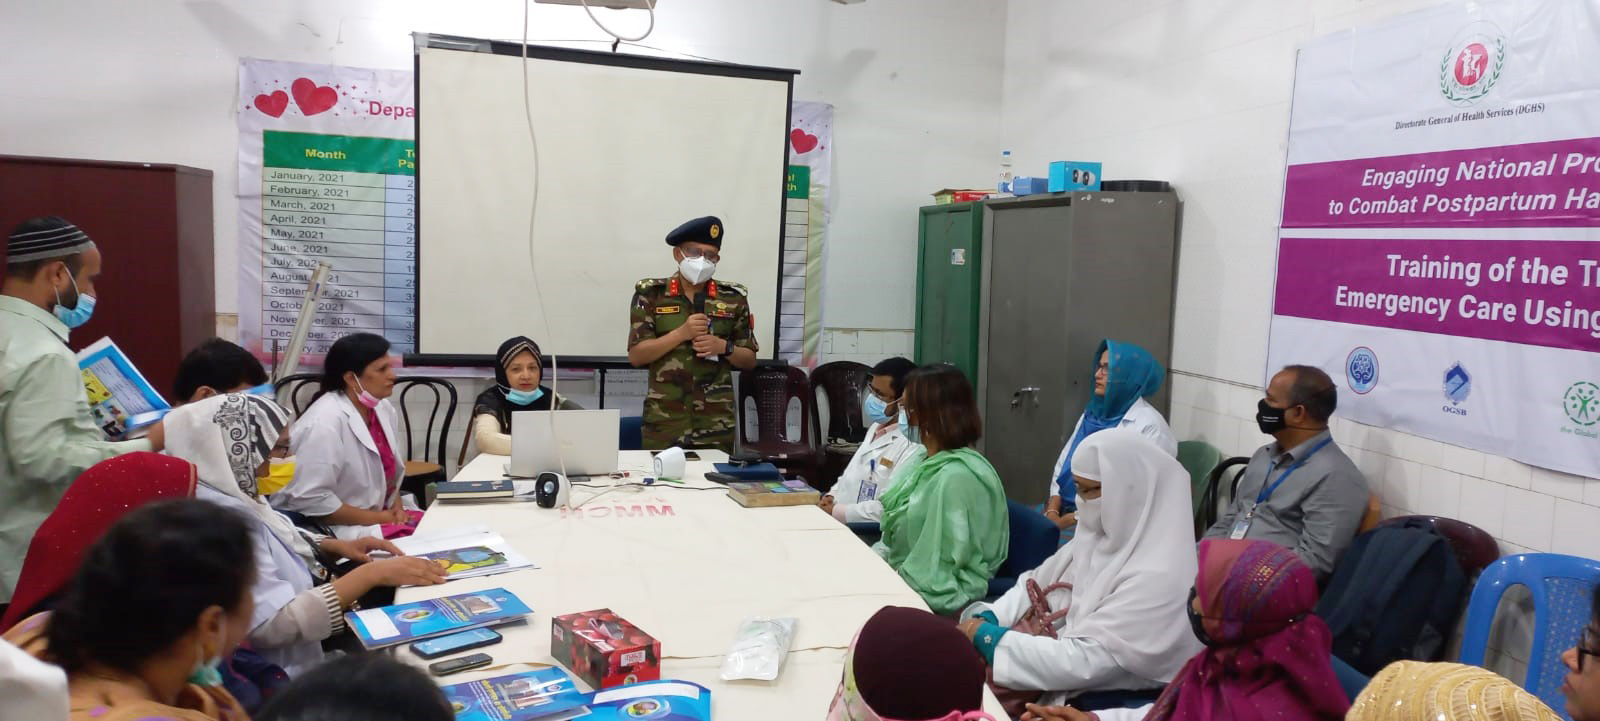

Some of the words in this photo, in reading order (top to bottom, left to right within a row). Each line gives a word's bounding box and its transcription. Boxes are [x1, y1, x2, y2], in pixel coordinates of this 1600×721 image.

[1395, 119, 1427, 130] Directorate
[1428, 115, 1453, 126] General
[1453, 113, 1461, 122] of
[1462, 110, 1485, 122] Health
[1486, 106, 1514, 119] Services
[1515, 103, 1545, 116] (DGHS)
[305, 149, 346, 160] Month
[271, 171, 315, 182] January,
[318, 174, 344, 182] 2021
[1362, 164, 1450, 190] Engaging
[1456, 153, 1558, 181] National
[270, 185, 320, 197] February,
[323, 189, 350, 197] 2021
[270, 200, 306, 211] March,
[310, 202, 335, 211] 2021
[1329, 200, 1344, 215] to
[1349, 195, 1418, 214] Combat
[1422, 192, 1557, 217] Postpartum
[270, 214, 297, 225] April,
[300, 216, 326, 225] 2021
[271, 229, 296, 240] May,
[299, 230, 324, 239] 2021
[303, 245, 328, 254] 2021
[271, 257, 294, 268] July,
[1387, 254, 1481, 287] Training
[1488, 256, 1516, 283] of
[1521, 257, 1569, 286] the
[334, 289, 359, 298] 2021
[318, 303, 344, 311] 2021
[1335, 285, 1451, 322] Emergency
[1458, 294, 1517, 322] Care
[331, 317, 356, 326] 2021
[1442, 405, 1468, 416] OGSB
